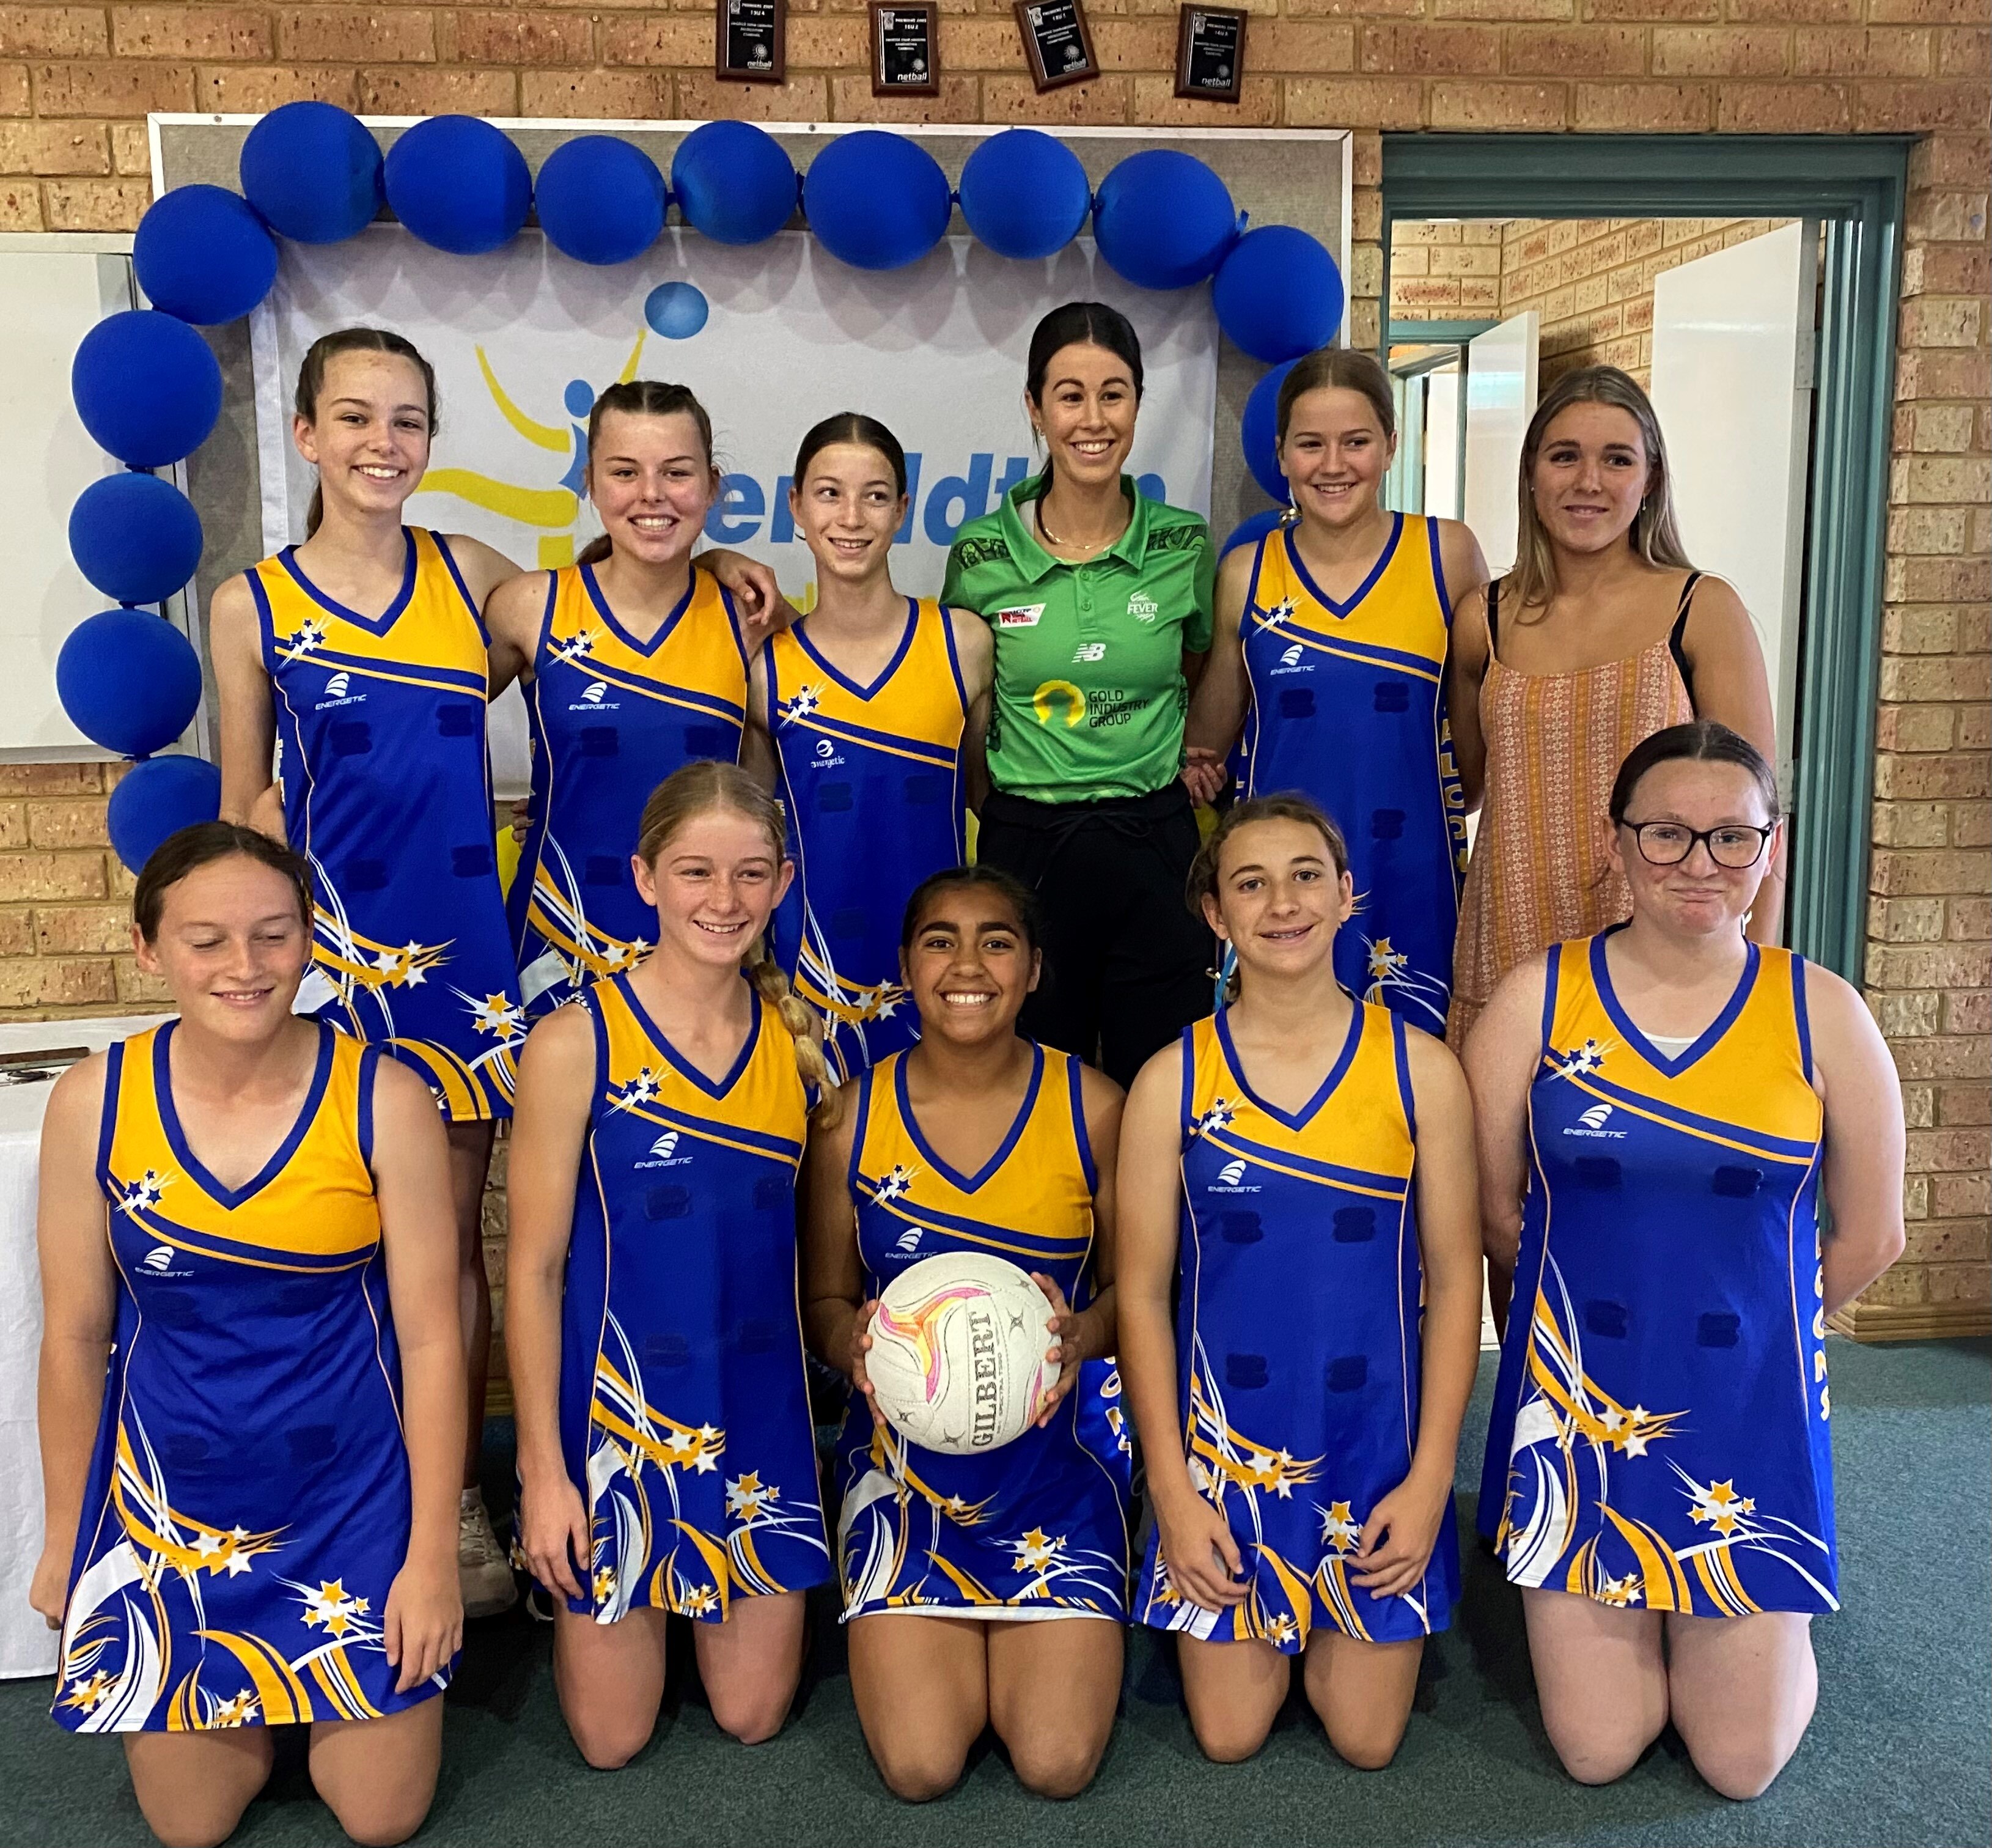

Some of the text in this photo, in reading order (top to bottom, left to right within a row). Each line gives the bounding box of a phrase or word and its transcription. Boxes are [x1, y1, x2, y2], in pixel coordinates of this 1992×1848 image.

[897, 72, 927, 81] netball
[1202, 78, 1231, 87] netball
[1127, 602, 1158, 614] FEVER
[1270, 665, 1315, 676] ENERGETIC
[315, 694, 367, 710] ENERGETIC
[1089, 690, 1124, 702] GOLD
[1089, 699, 1150, 715] INDUSTRY
[1089, 713, 1131, 727] GROUP
[1563, 1128, 1628, 1138] ENERGETIC
[634, 1157, 693, 1169] ENERGETIC
[969, 1311, 998, 1446] GILBERT
